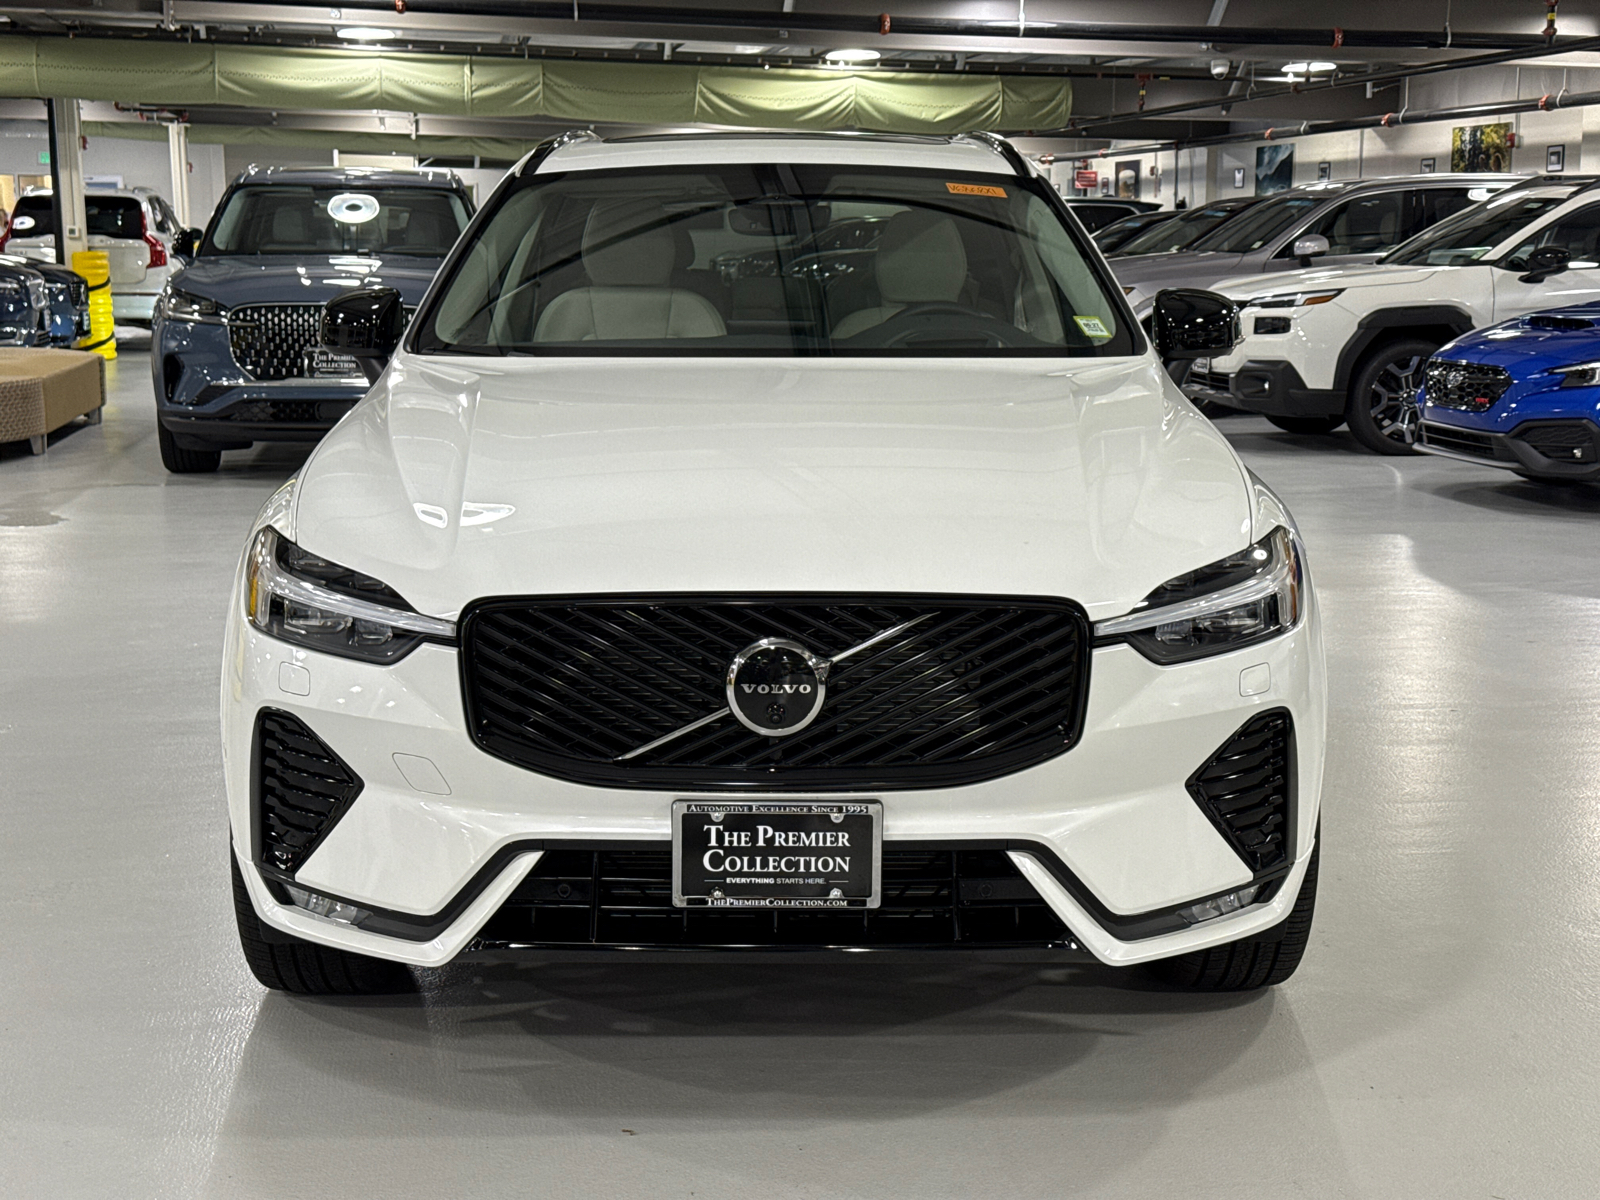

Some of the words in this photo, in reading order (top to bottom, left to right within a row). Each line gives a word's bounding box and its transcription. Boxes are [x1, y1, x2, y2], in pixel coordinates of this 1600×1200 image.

[740, 683, 812, 694] VOLVO
[841, 805, 867, 814] 1995
[703, 824, 752, 847] THE
[756, 825, 851, 847] PREMIER
[702, 849, 851, 873] COLLECTION
[726, 877, 775, 885] EVERYTHING
[776, 877, 804, 885] STARTS
[804, 877, 827, 885] HERE.
